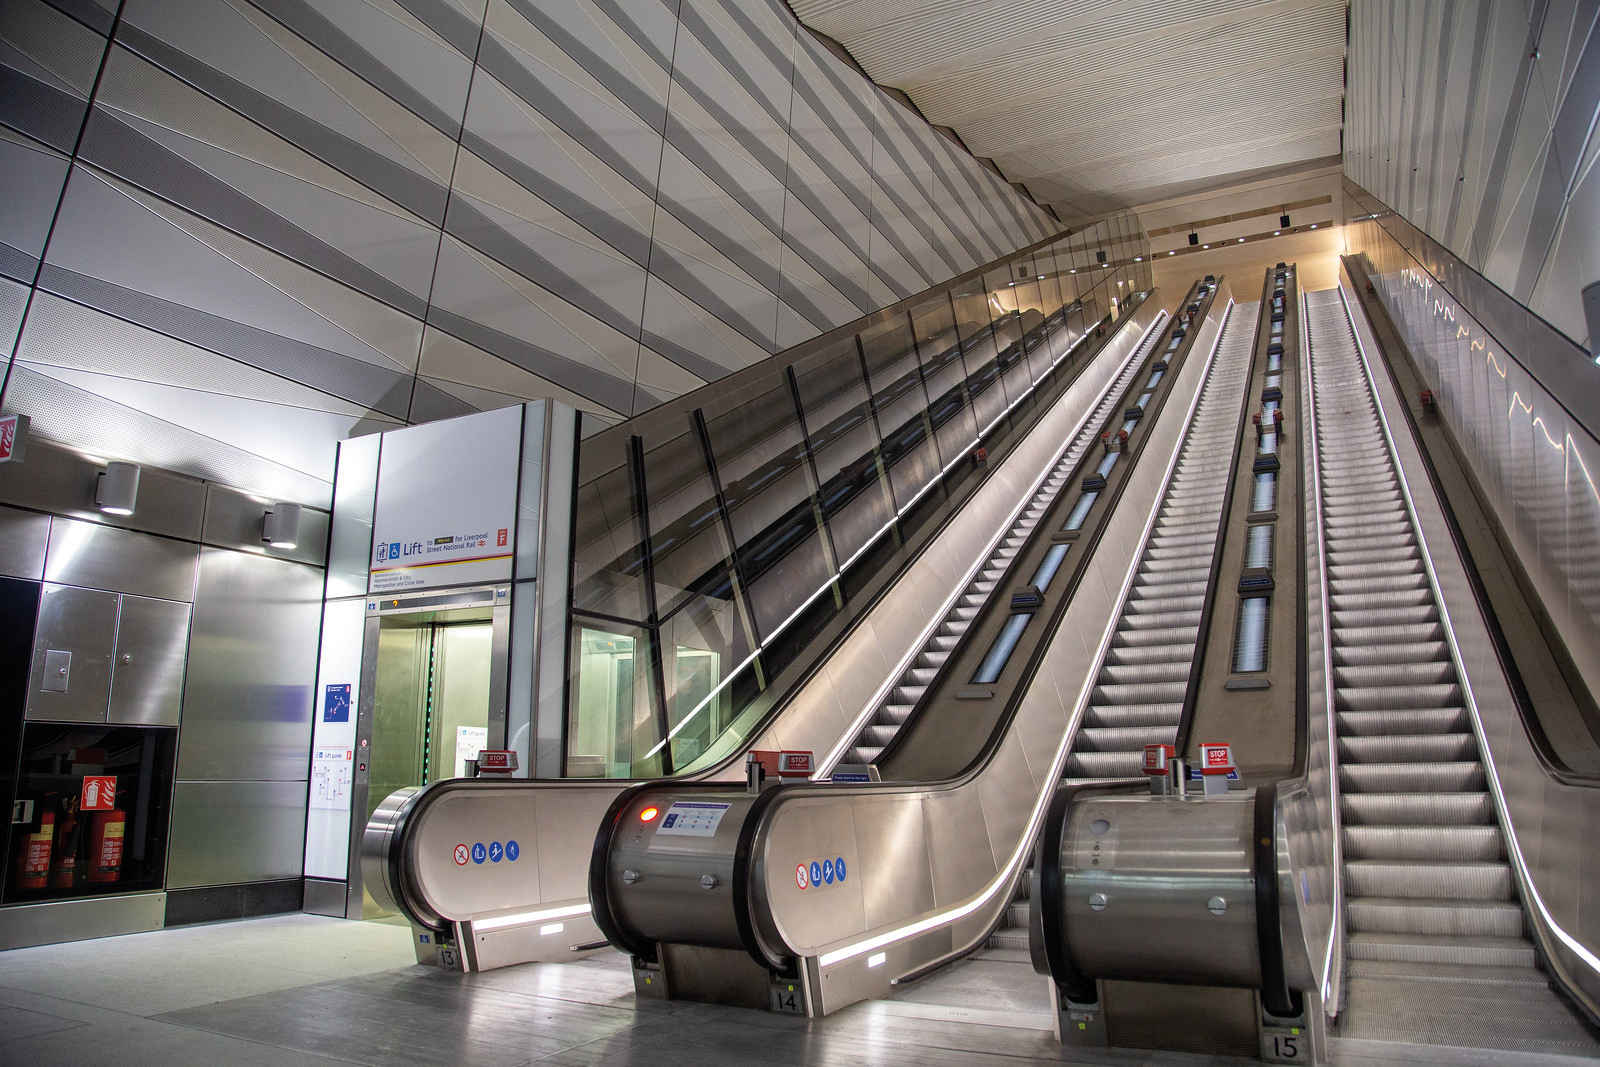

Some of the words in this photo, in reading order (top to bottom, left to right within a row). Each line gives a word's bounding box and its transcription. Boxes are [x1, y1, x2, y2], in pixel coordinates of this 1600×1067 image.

[464, 533, 488, 541] Liverpool
[500, 535, 505, 544] F
[404, 542, 422, 556] Lift
[444, 543, 464, 551] National
[442, 950, 454, 965] 13
[778, 992, 797, 1010] 14
[1274, 1037, 1297, 1058] 15
